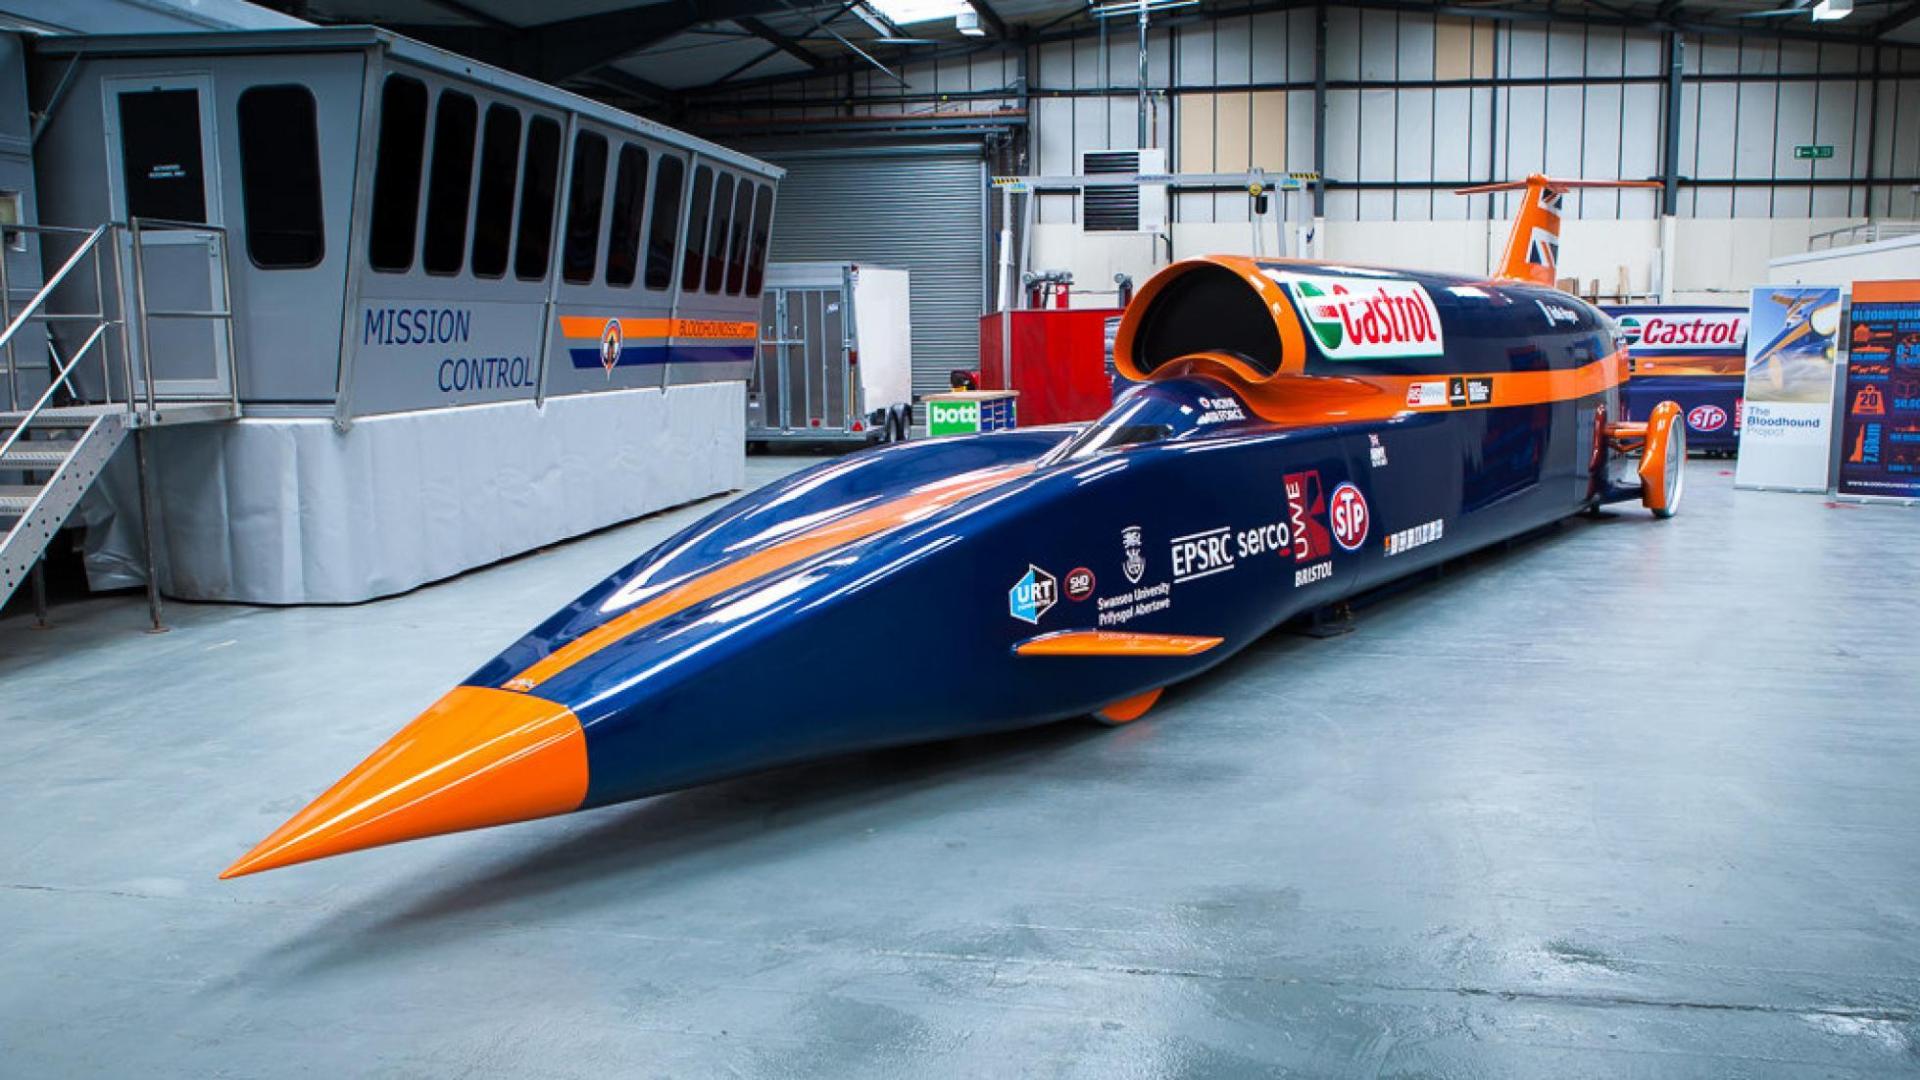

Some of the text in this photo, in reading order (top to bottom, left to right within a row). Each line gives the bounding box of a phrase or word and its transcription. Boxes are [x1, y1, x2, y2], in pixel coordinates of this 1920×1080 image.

[364, 308, 471, 346] MISSION
[1333, 283, 1437, 346] Castrol
[1643, 318, 1740, 345] Castrol
[438, 356, 534, 392] CONTROL
[933, 405, 977, 424] bott
[1690, 407, 1725, 428] STP
[1747, 416, 1820, 428] Bloodhound
[1749, 406, 1771, 416] The
[1286, 482, 1309, 560] UWE
[1336, 492, 1364, 541] STP
[1237, 522, 1289, 558] serco
[1171, 533, 1234, 576] EPSRC
[1295, 561, 1332, 587] BRISTOL
[1017, 580, 1052, 603] URT
[1098, 582, 1170, 610] Swansea University
[1135, 598, 1170, 616] Abertawe
